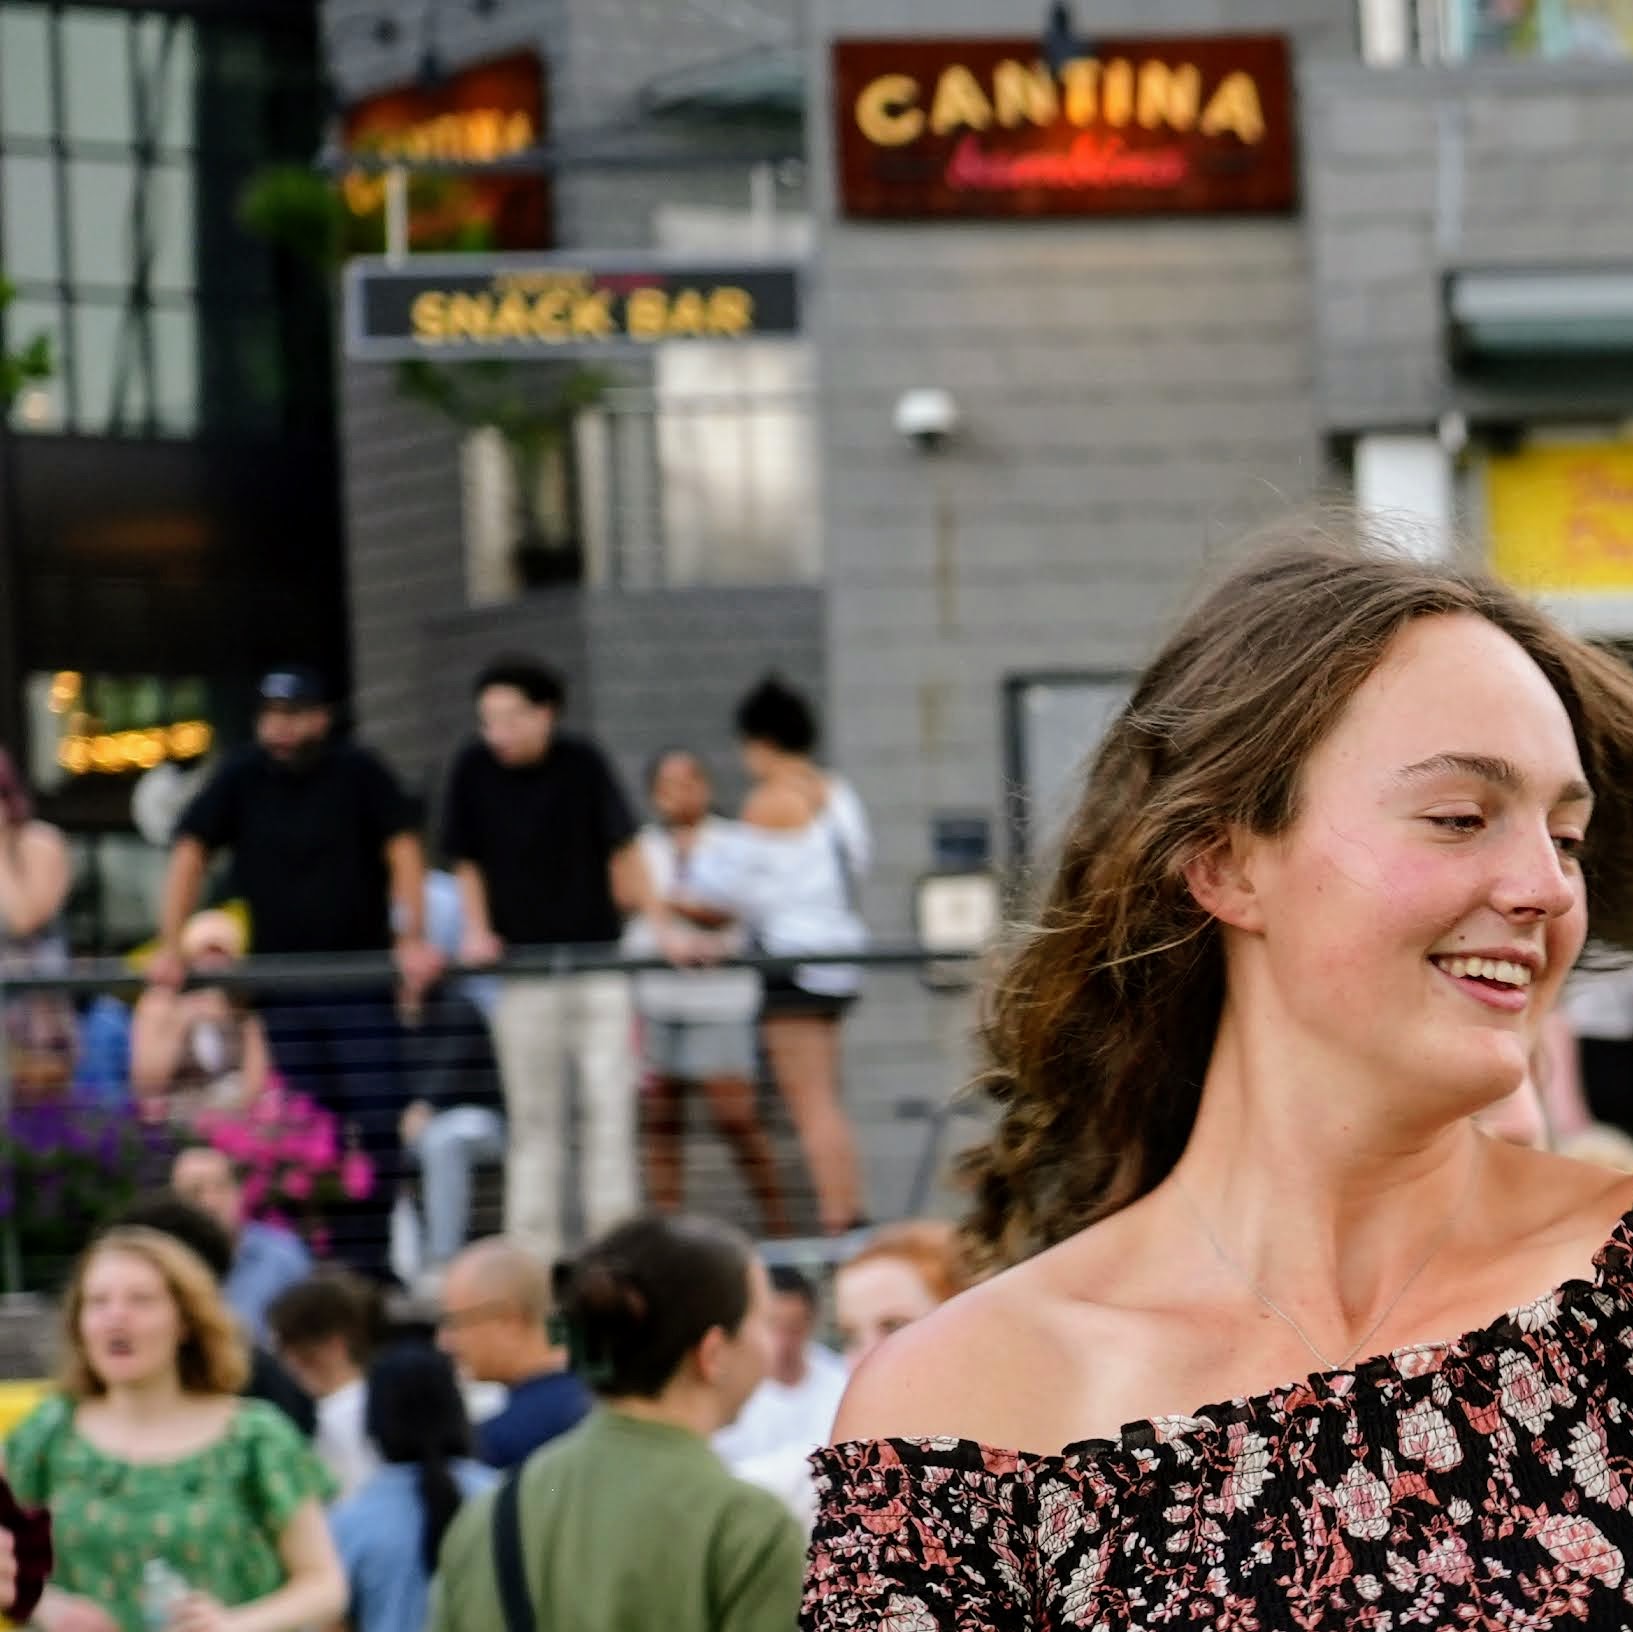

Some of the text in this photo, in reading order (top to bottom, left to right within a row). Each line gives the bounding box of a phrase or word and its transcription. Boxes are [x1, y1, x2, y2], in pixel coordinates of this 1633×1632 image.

[854, 58, 1267, 146] CANTINA
[412, 287, 753, 343] SNACK BAR
